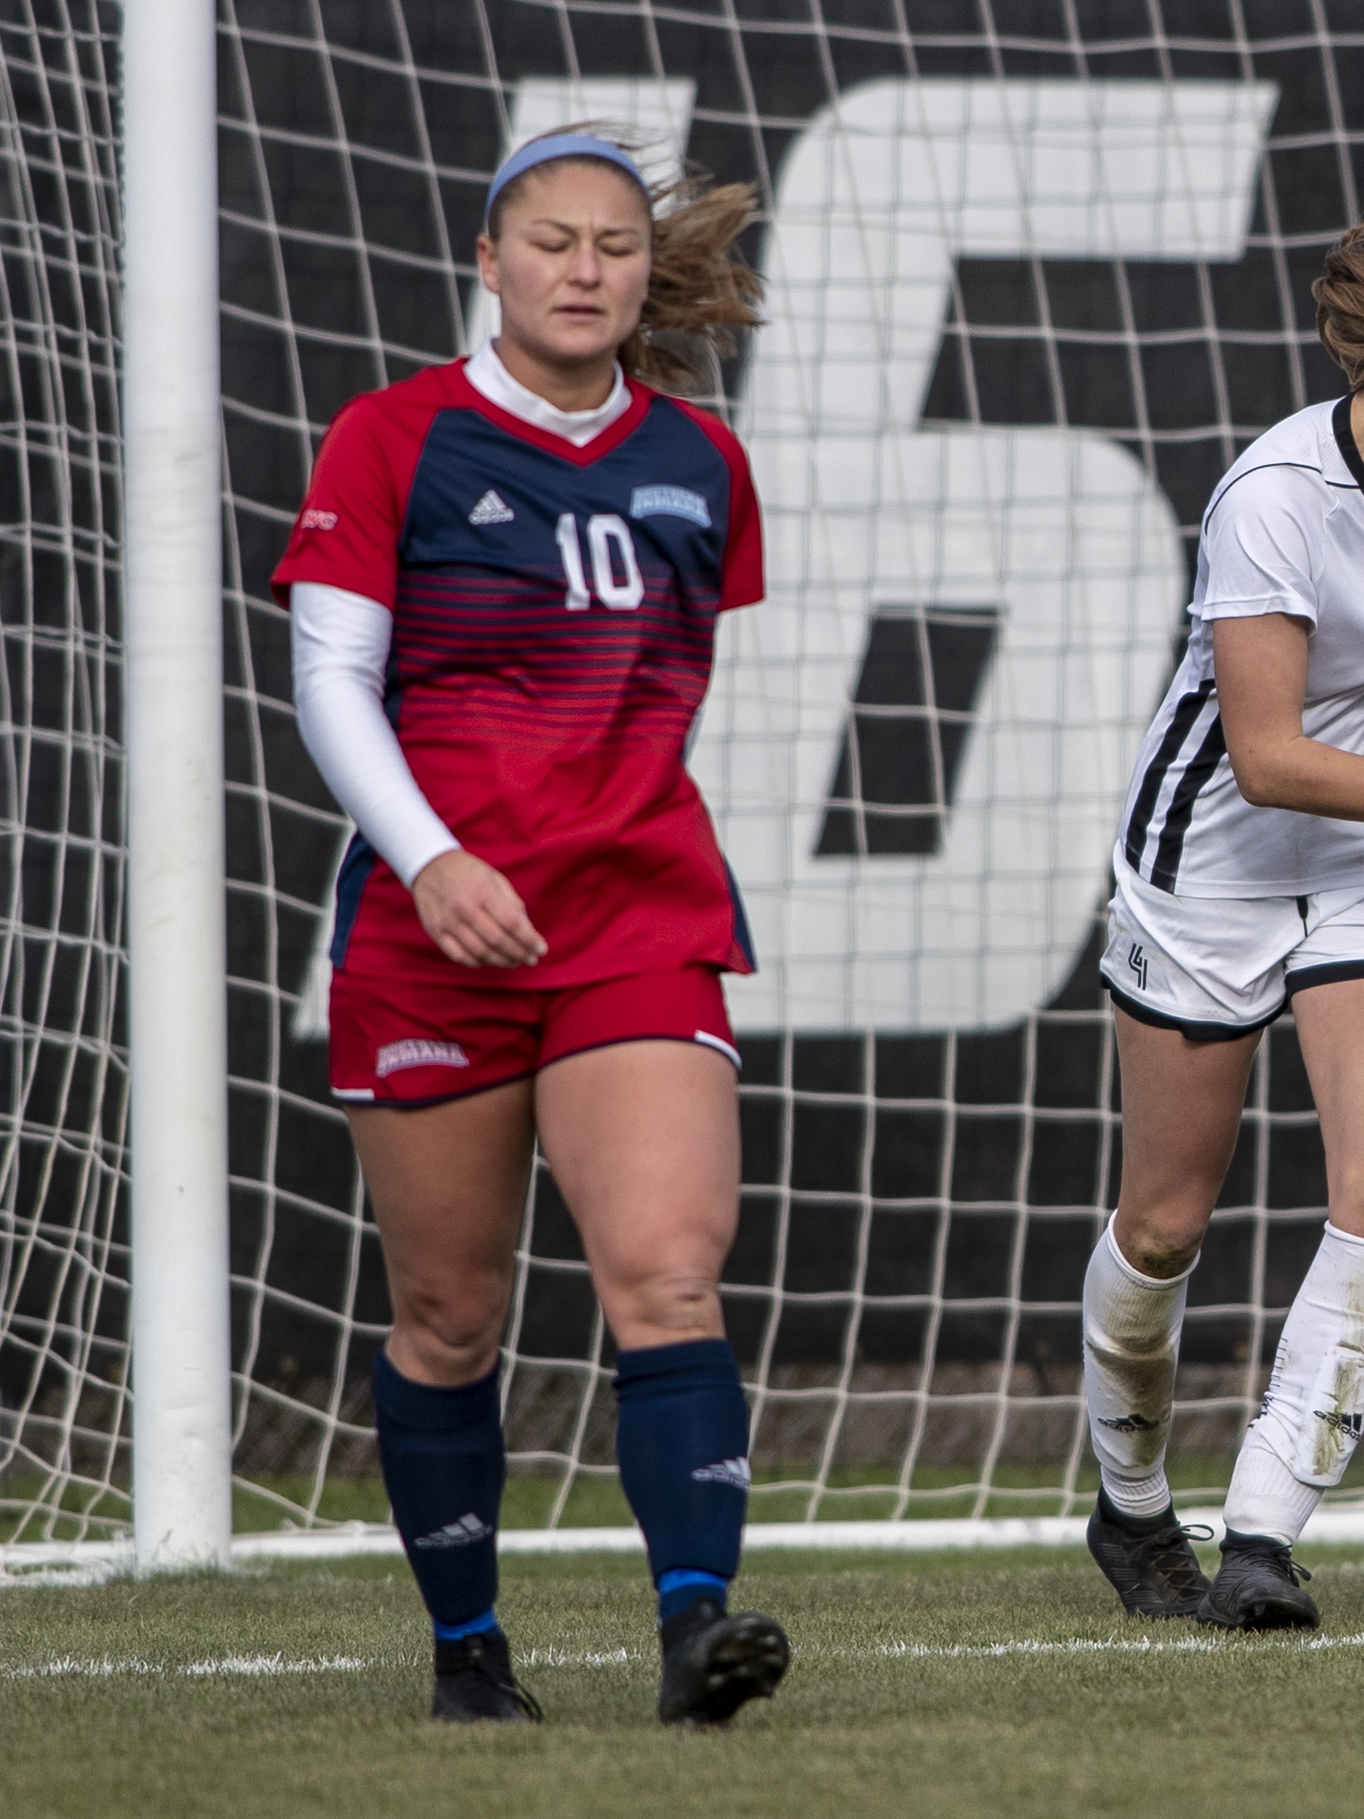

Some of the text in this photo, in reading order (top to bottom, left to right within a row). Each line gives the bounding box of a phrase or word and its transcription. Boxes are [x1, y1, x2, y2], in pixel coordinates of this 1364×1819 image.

[555, 512, 645, 611] 10
[1128, 942, 1149, 991] 4
[1313, 1410, 1361, 1441] adidas
